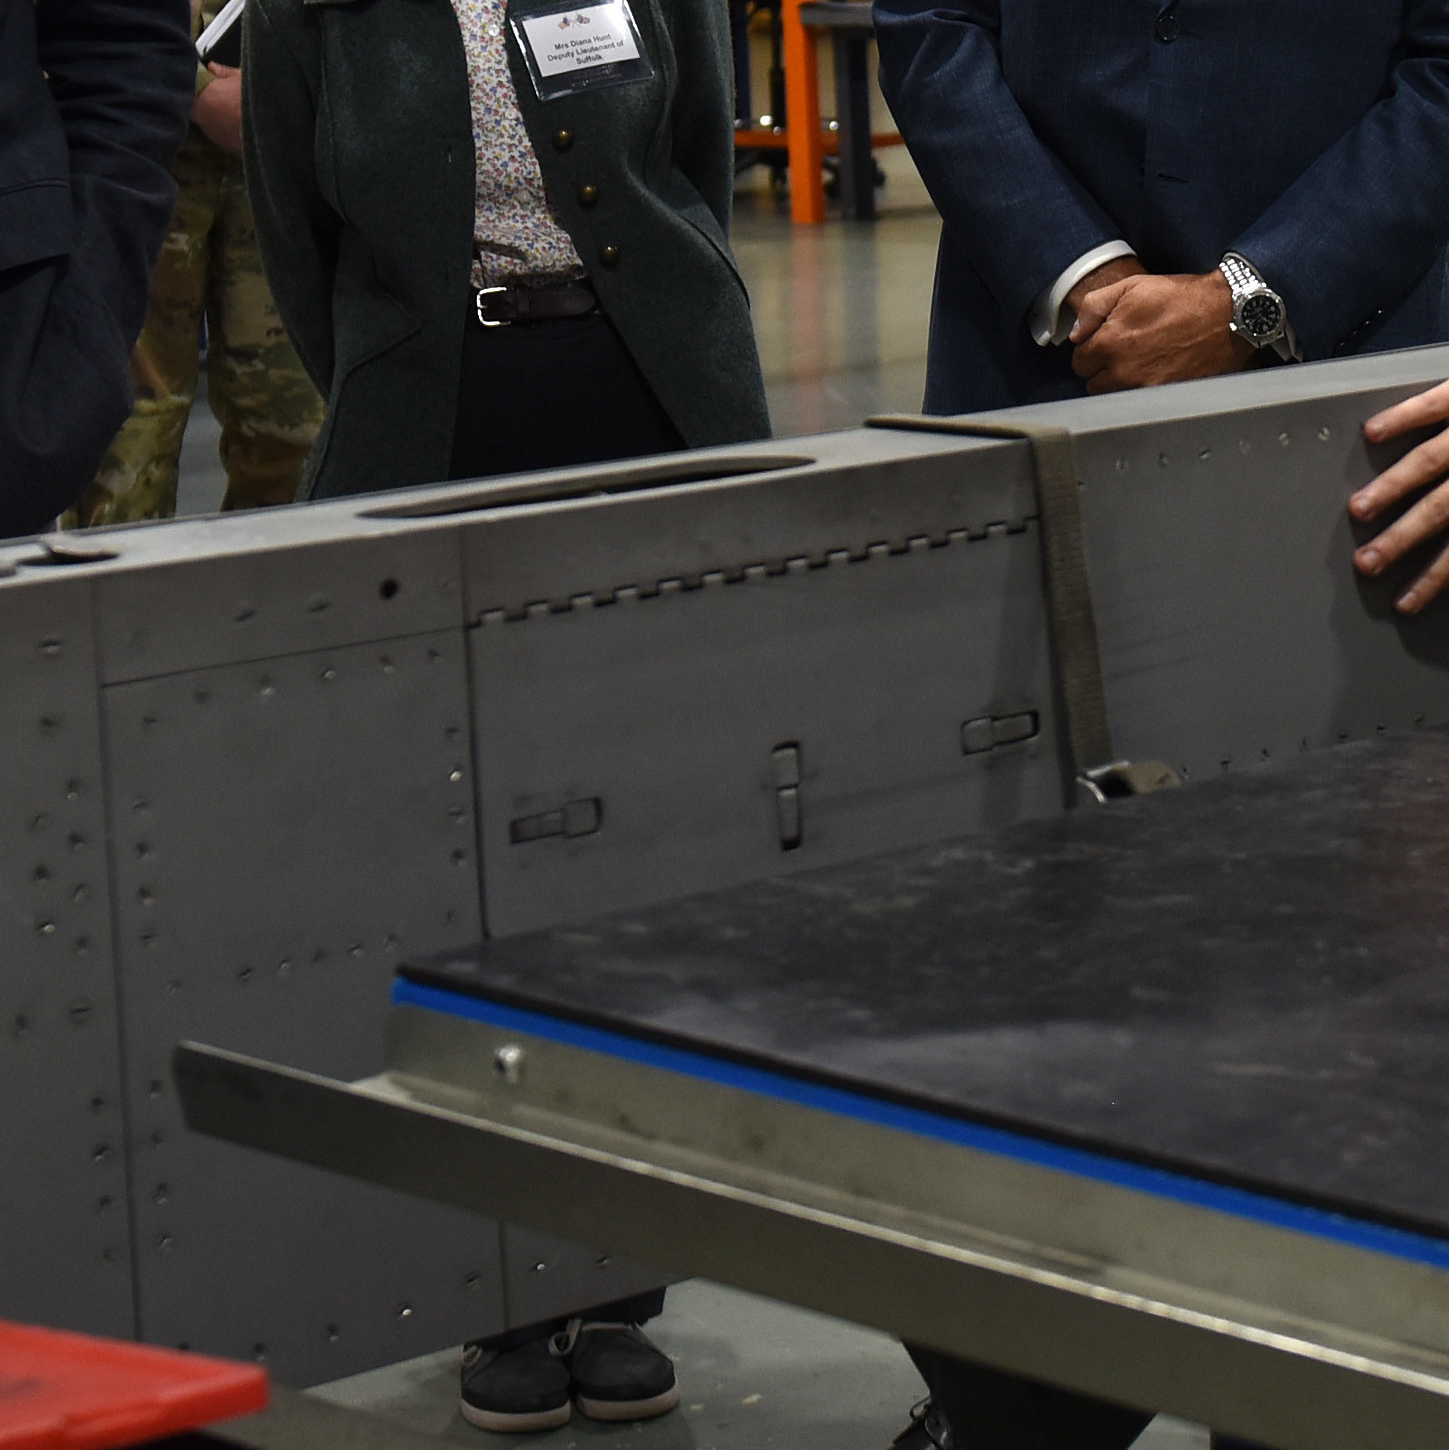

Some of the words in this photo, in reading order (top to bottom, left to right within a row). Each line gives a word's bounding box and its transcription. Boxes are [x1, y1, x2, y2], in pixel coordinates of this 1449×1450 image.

[547, 50, 575, 62] Deputy
[576, 42, 615, 56] Lieutenant
[616, 39, 625, 48] of
[554, 41, 570, 51] Mrs
[570, 37, 593, 48] Diana
[593, 33, 612, 43] Hunt
[575, 53, 604, 65] Suffolk
